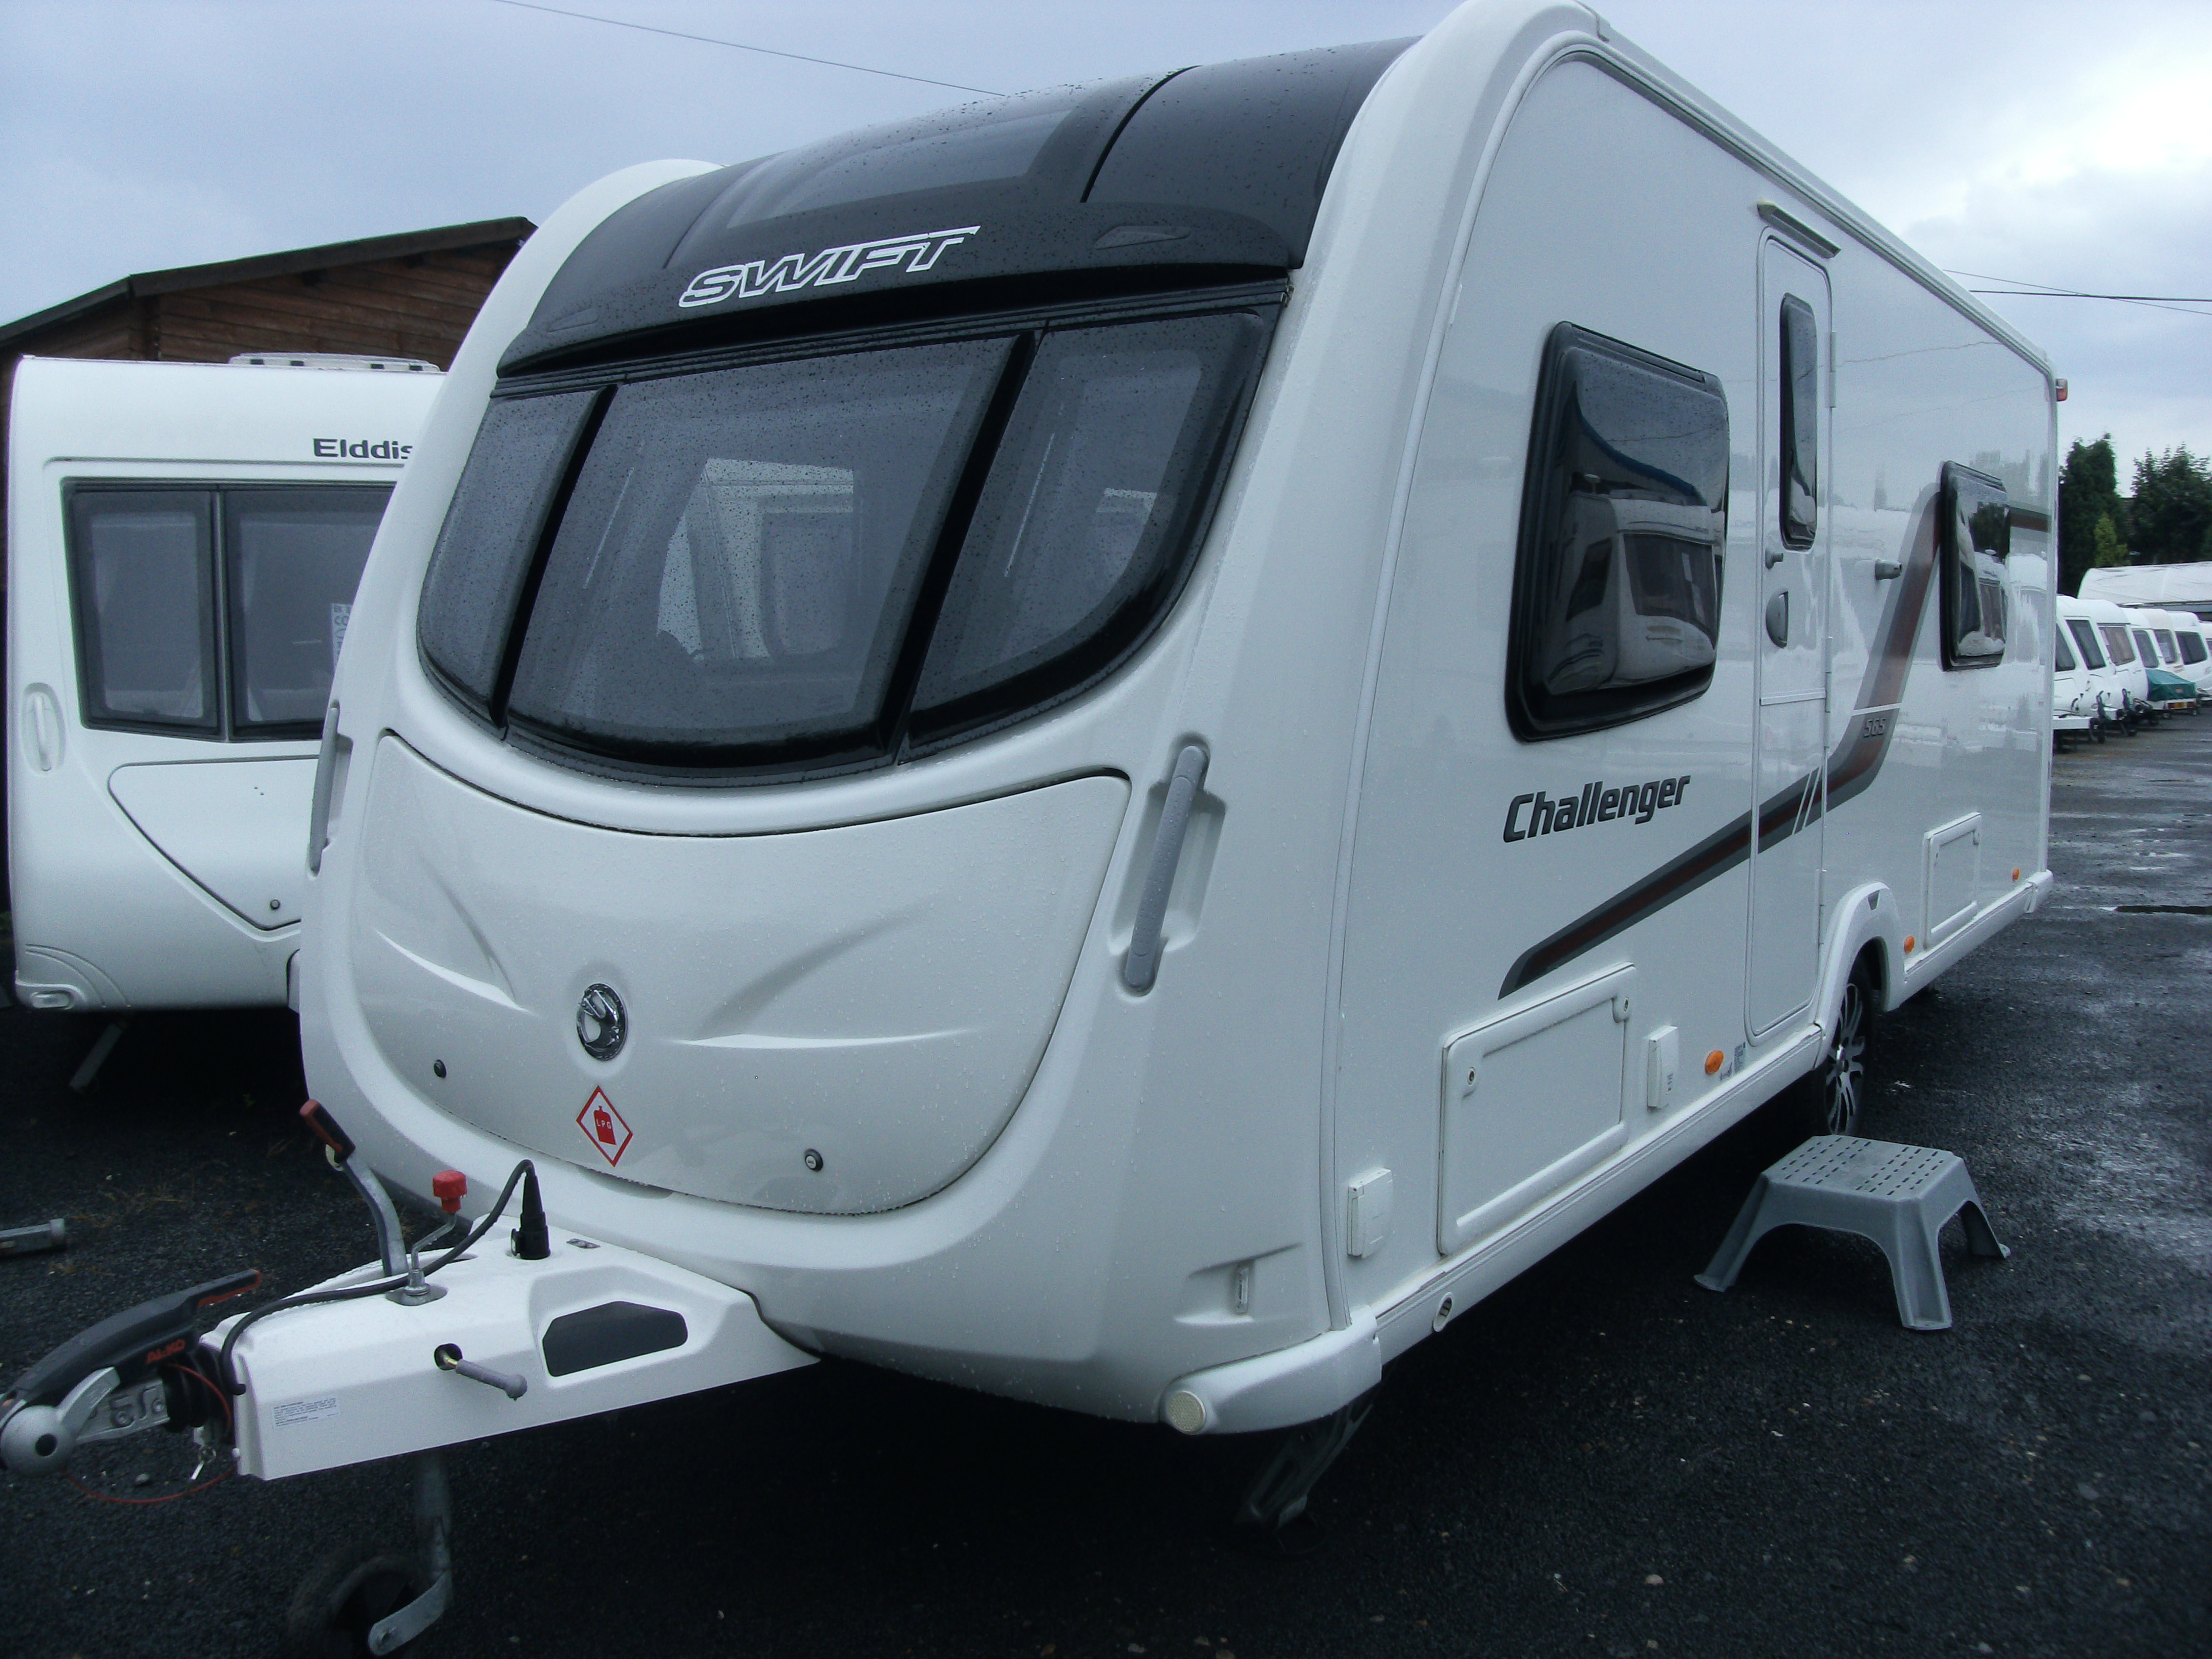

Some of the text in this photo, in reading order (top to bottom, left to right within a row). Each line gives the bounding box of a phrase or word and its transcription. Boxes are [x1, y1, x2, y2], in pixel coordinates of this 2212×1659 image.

[679, 225, 980, 307] SWIFT
[1503, 775, 1691, 842] Challenger
[597, 1119, 611, 1129] LPG
